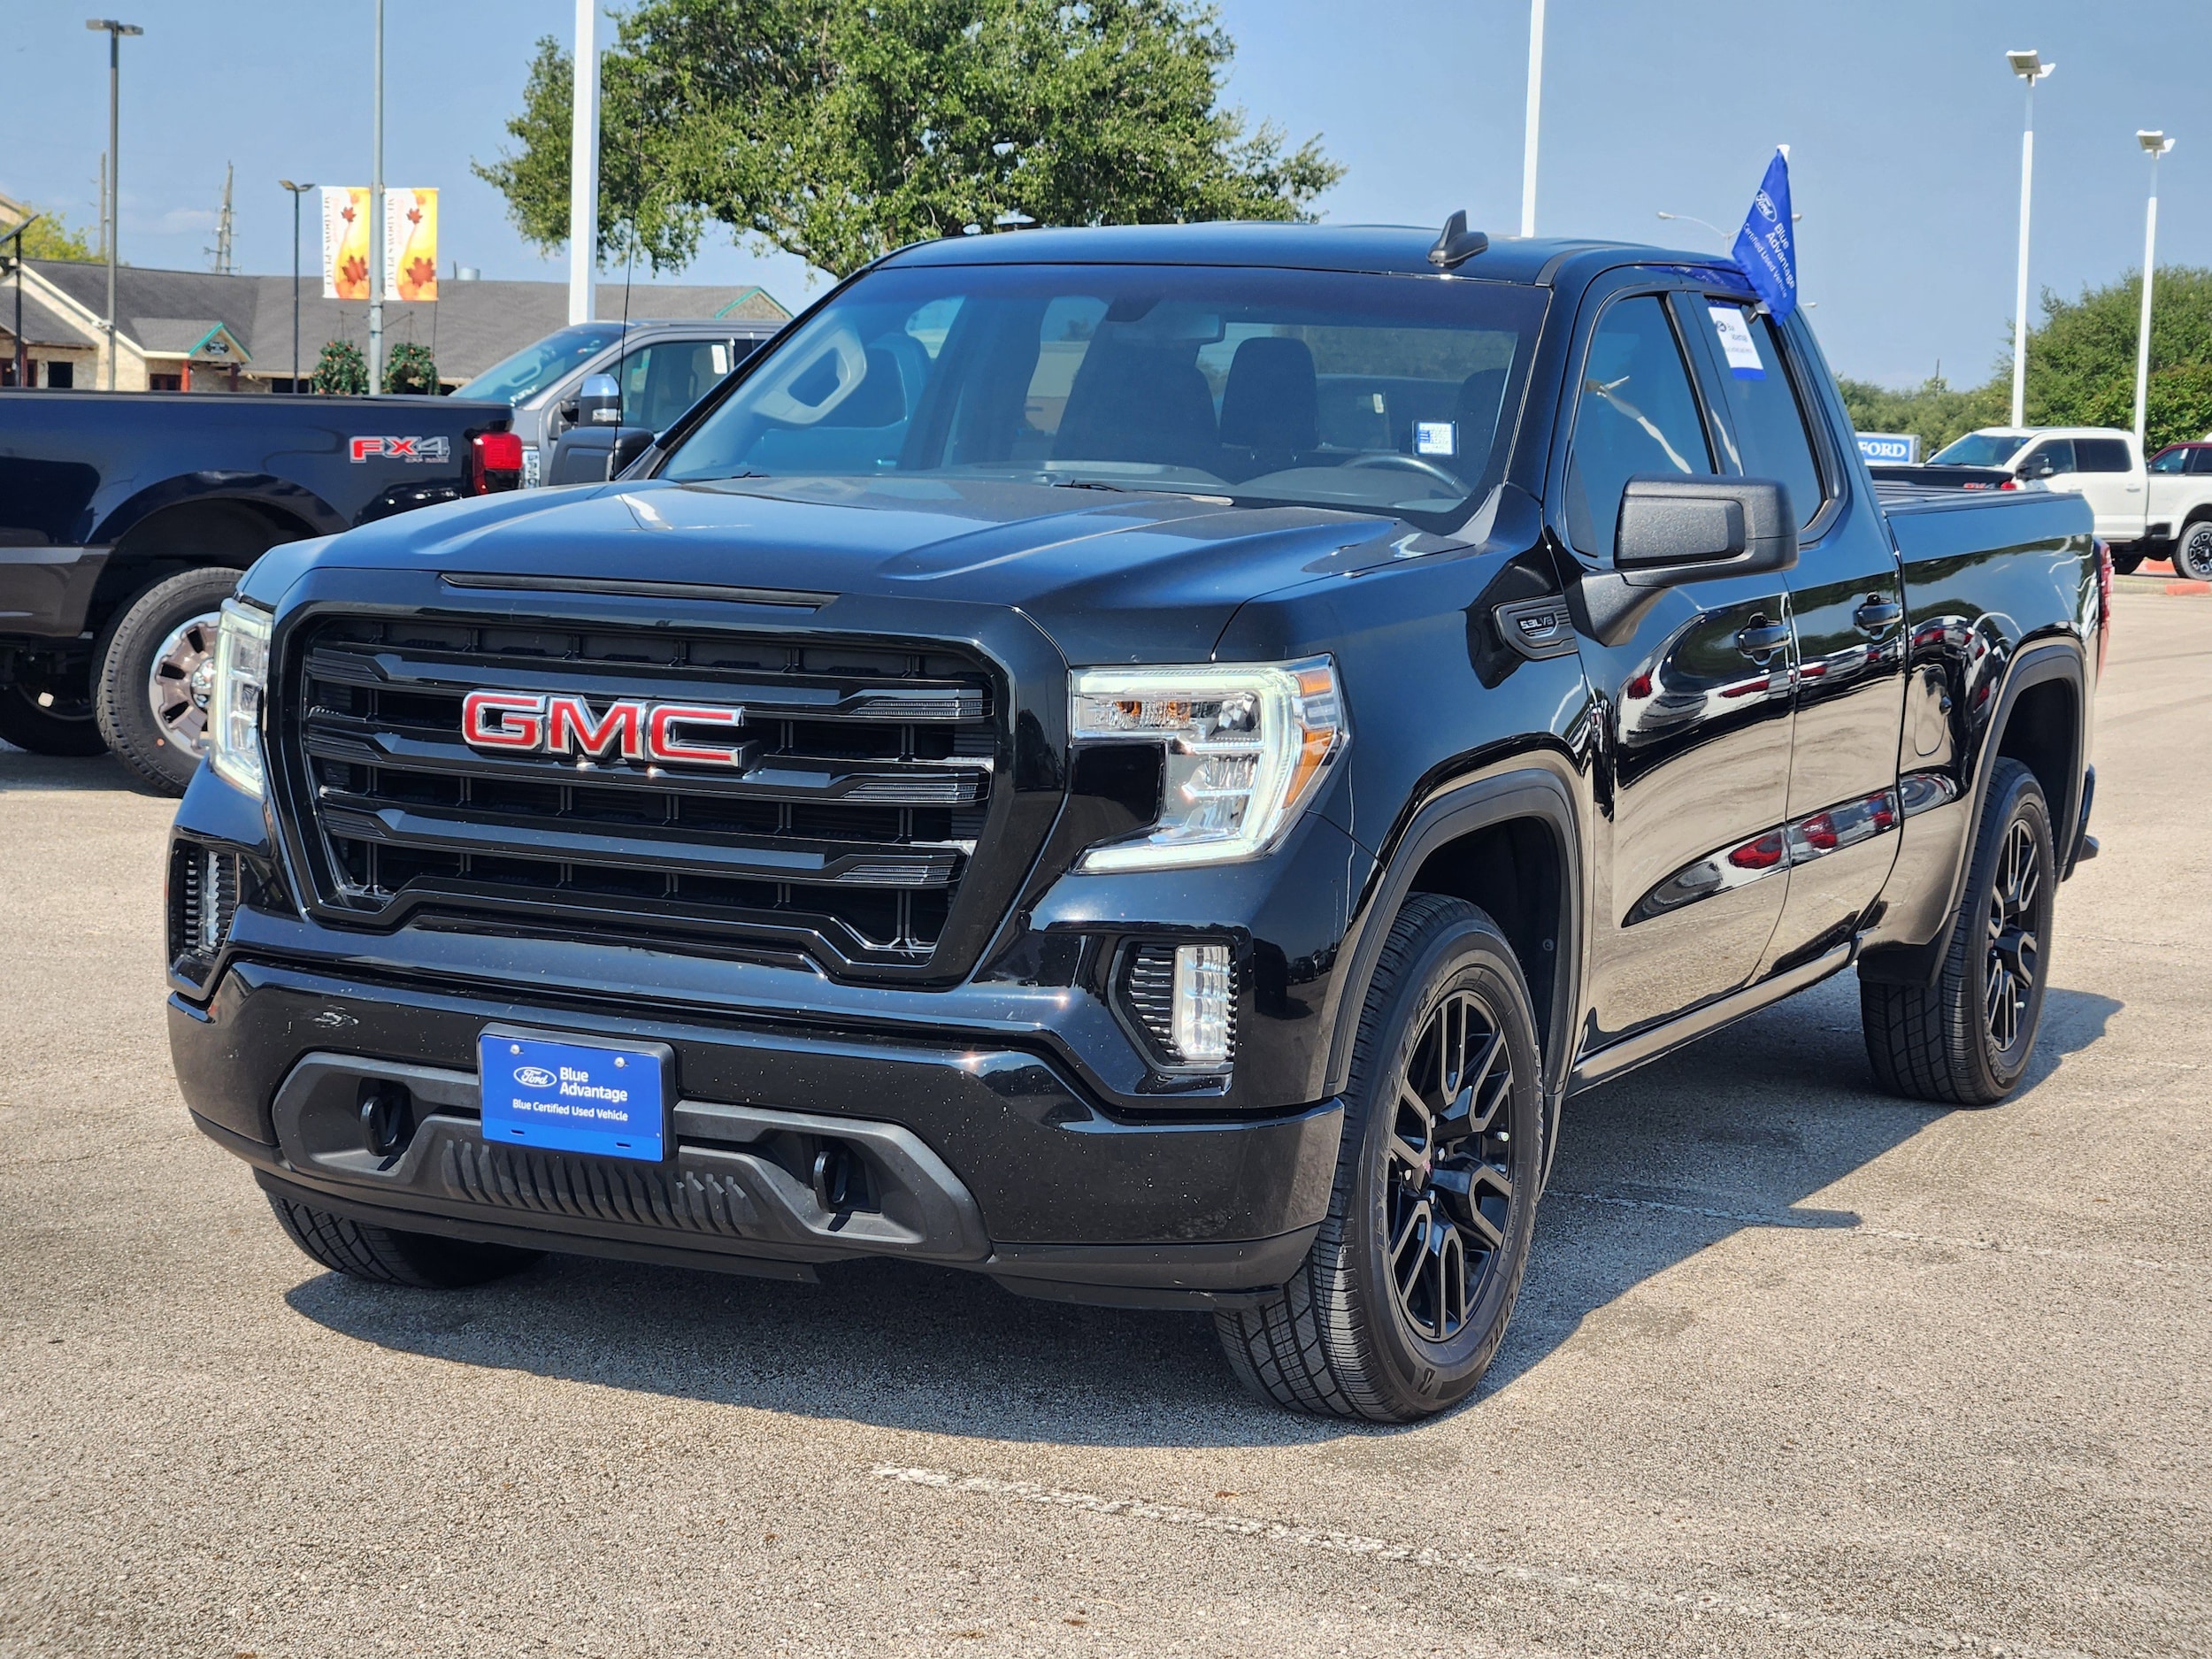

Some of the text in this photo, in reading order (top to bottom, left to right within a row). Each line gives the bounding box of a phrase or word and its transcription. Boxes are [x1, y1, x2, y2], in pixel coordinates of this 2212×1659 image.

[1755, 193, 1773, 216] Ford
[1774, 223, 1789, 250] Blue
[1743, 222, 1787, 298] Certified Used Vehicle
[1765, 232, 1795, 288] Advantage
[349, 436, 450, 463] FX4
[1858, 442, 1907, 457] FORD
[462, 688, 745, 768] GMC
[520, 1069, 549, 1085] Ford
[559, 1066, 589, 1083] Blue
[559, 1081, 628, 1103] Advantage
[512, 1098, 628, 1122] Blue Certified Used Vehicle
